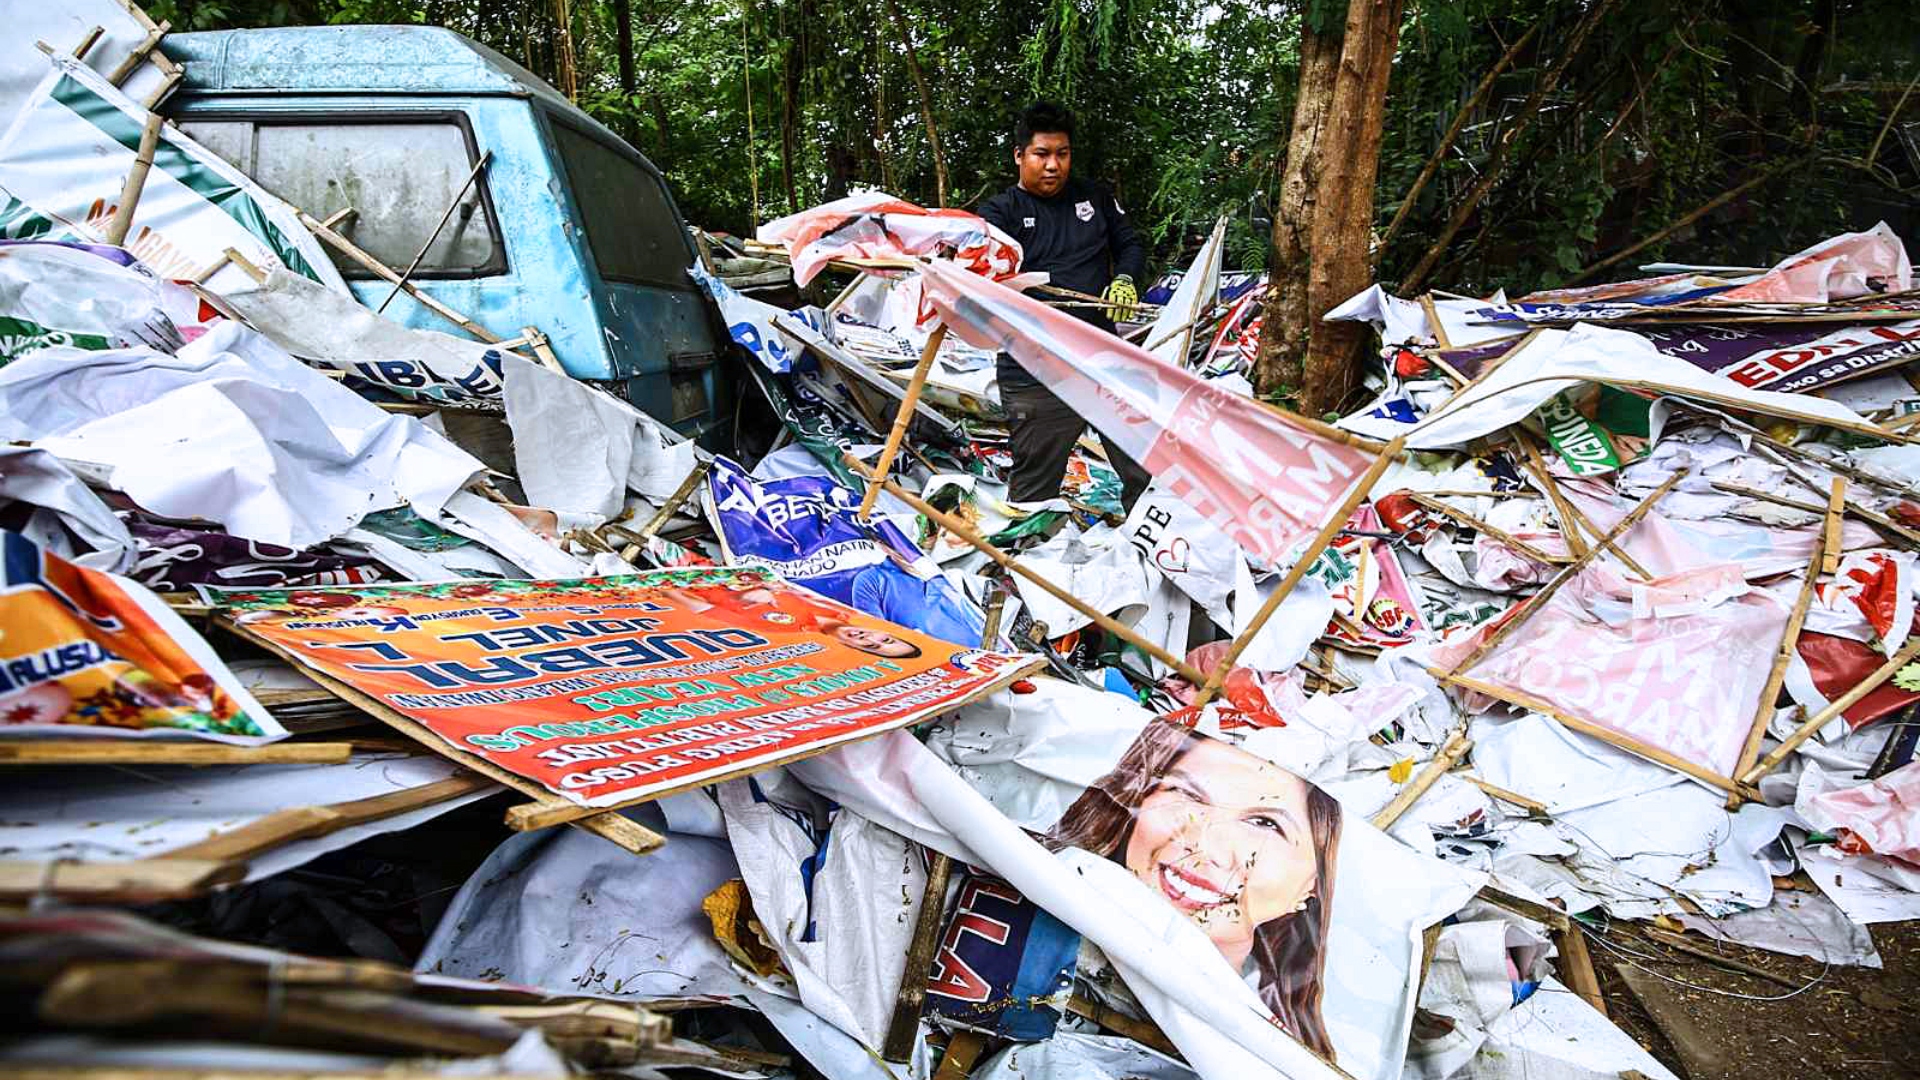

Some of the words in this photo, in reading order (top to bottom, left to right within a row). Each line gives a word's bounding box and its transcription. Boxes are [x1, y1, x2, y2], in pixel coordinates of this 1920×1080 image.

[1541, 404, 1616, 477] PINEDA
[825, 539, 876, 558] NATIN
[287, 616, 421, 632] KALUSUGAN
[411, 606, 524, 623] EDUKASYON
[303, 640, 409, 661] L.
[438, 616, 662, 652] JONEL
[348, 628, 769, 689] QUEBAL
[730, 662, 818, 688] NEW
[498, 677, 597, 702] WALANG
[572, 678, 738, 712] YEAR!
[784, 664, 884, 698] JOYOUS
[466, 693, 767, 753] PROSPEROUS
[737, 704, 827, 731] BAYAN
[537, 720, 745, 767] PARTYLIST
[559, 754, 693, 789] PUSO
[926, 866, 1024, 1005] LLA
